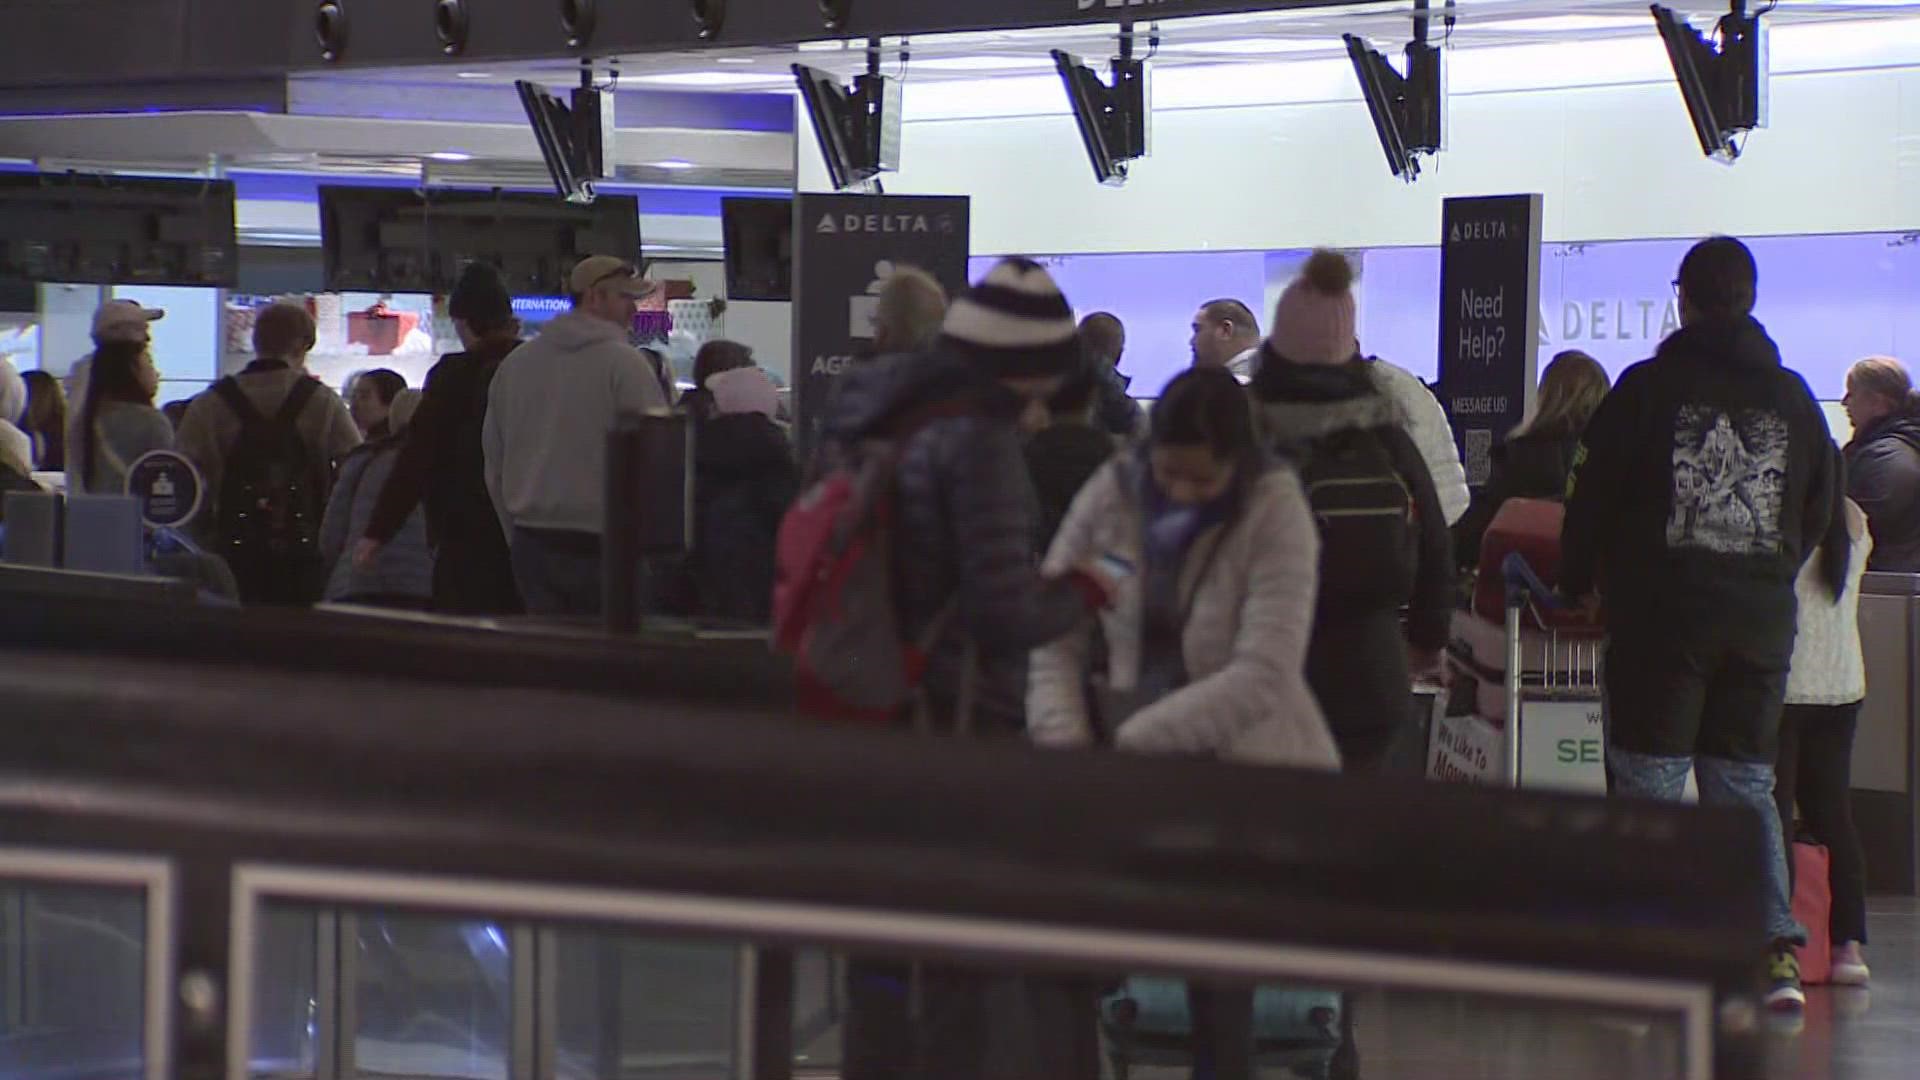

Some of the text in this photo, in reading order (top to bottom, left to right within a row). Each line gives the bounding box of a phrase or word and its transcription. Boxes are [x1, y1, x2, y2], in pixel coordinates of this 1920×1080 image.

[843, 214, 928, 232] DELTA
[1464, 222, 1507, 241] DELTA
[1460, 286, 1503, 320] Need
[1563, 300, 1679, 341] DELTA
[1458, 326, 1505, 366] Help?
